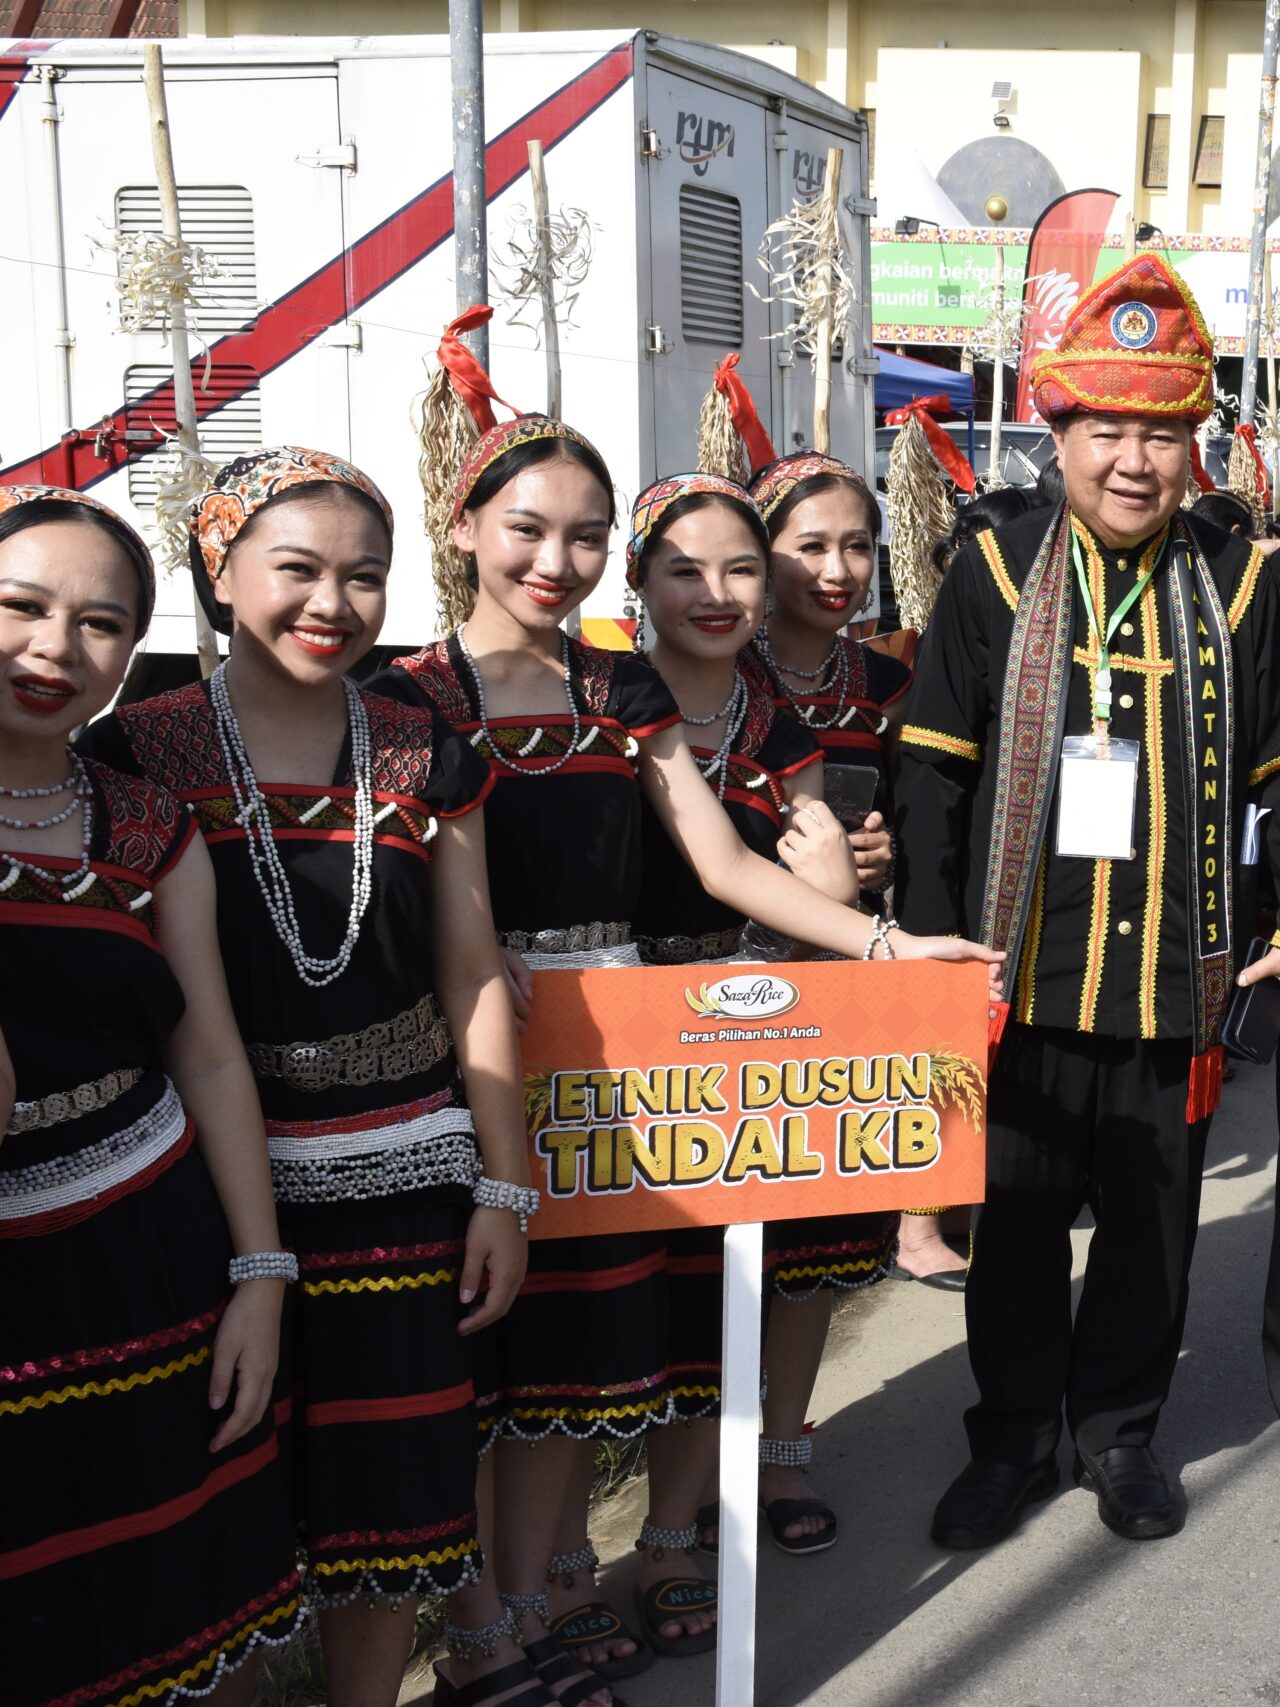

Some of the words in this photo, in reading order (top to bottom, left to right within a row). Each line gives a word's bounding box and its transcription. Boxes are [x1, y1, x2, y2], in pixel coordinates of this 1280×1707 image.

[871, 260, 933, 282] gkaian
[872, 288, 929, 308] muniti
[1187, 552, 1218, 801] AMATAN
[1204, 824, 1218, 944] 2023
[680, 1031, 716, 1043] Beras
[718, 1028, 761, 1042] Pilihan
[763, 1027, 788, 1039] No.1
[789, 1025, 821, 1038] Anda
[553, 1065, 728, 1121] ETNIK
[741, 1055, 930, 1110] DUSUN
[538, 1115, 823, 1195] TINDAL
[839, 1107, 940, 1174] KB
[668, 1588, 715, 1604] Nice
[562, 1616, 611, 1637] Nice
